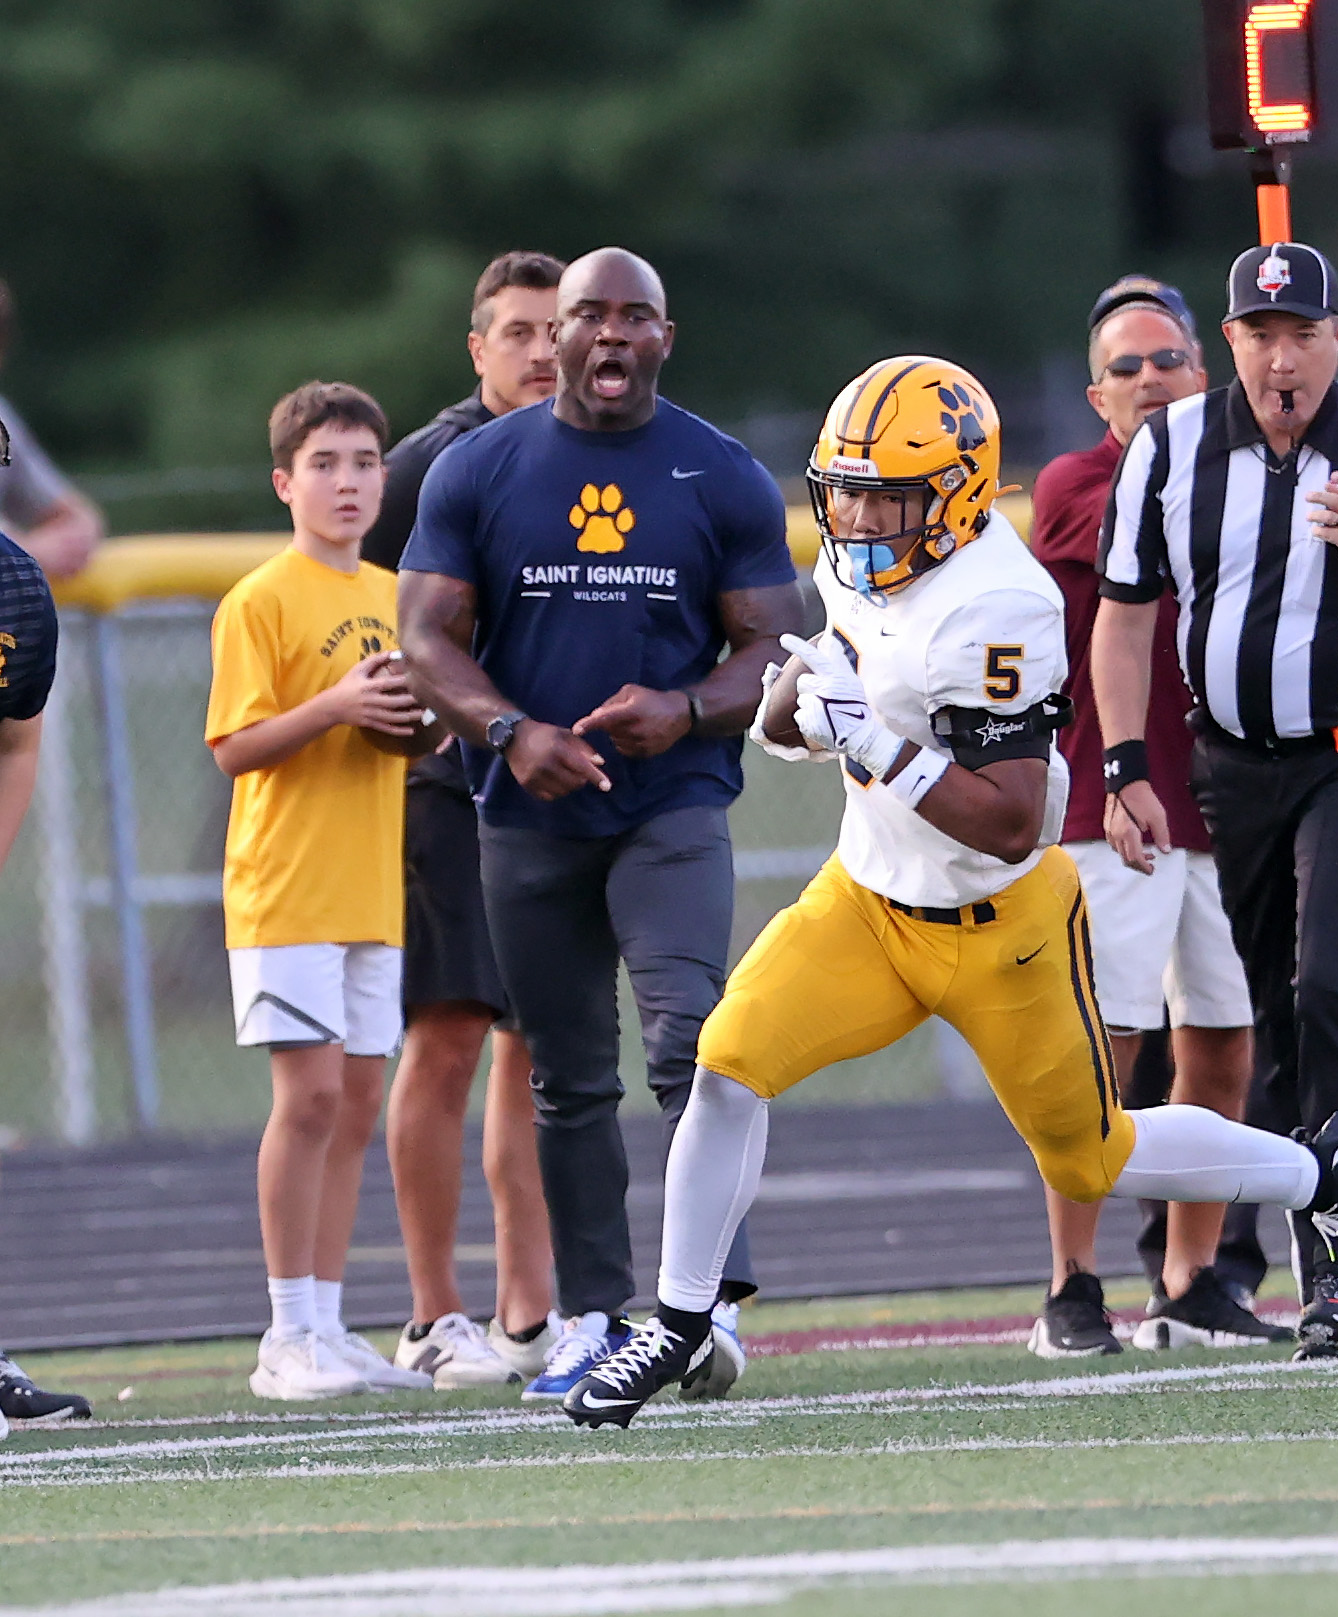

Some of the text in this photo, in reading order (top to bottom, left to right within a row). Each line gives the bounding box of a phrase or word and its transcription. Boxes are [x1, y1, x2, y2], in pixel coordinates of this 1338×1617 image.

[522, 565, 677, 588] SAINT IGNATIUS
[573, 590, 627, 602] WILDCATS
[320, 618, 354, 657] SAINT
[983, 643, 1024, 703] 5
